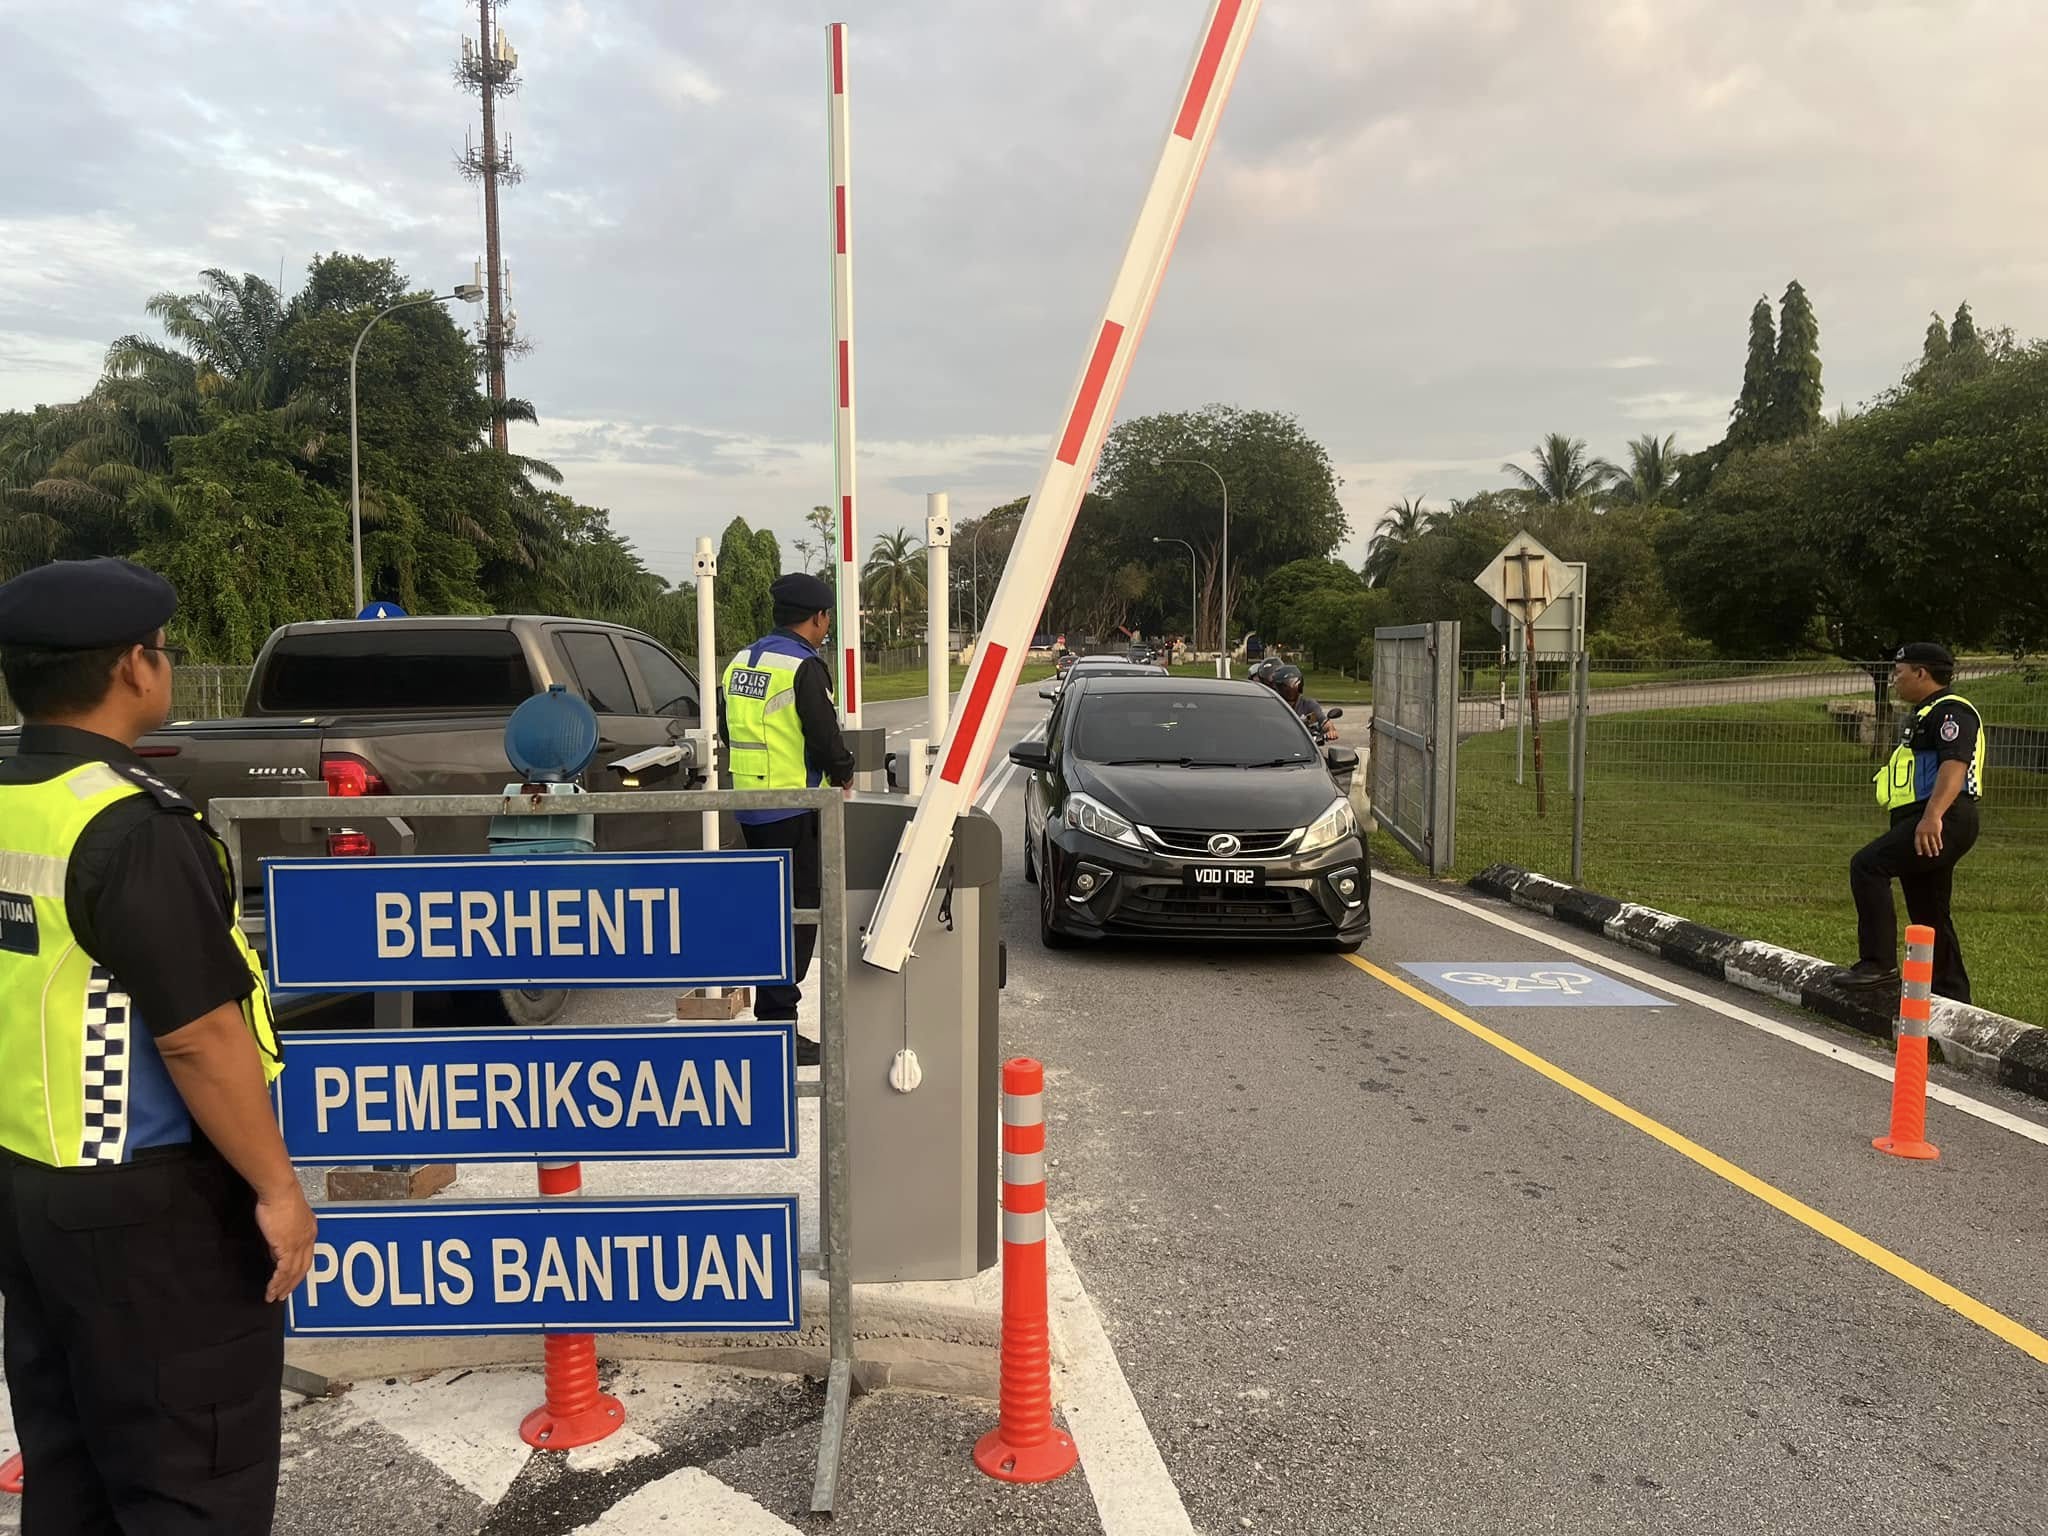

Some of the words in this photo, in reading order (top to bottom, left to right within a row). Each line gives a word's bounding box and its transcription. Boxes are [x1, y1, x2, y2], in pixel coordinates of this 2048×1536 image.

[732, 671, 766, 688] POLIS
[1225, 869, 1254, 884] 1782
[0, 900, 34, 924] TUAN
[375, 887, 681, 958] BERHENTI
[314, 1059, 752, 1133] PEMERIKSAAN
[306, 1238, 474, 1307] POLIS
[491, 1233, 773, 1303] BANTUAN
